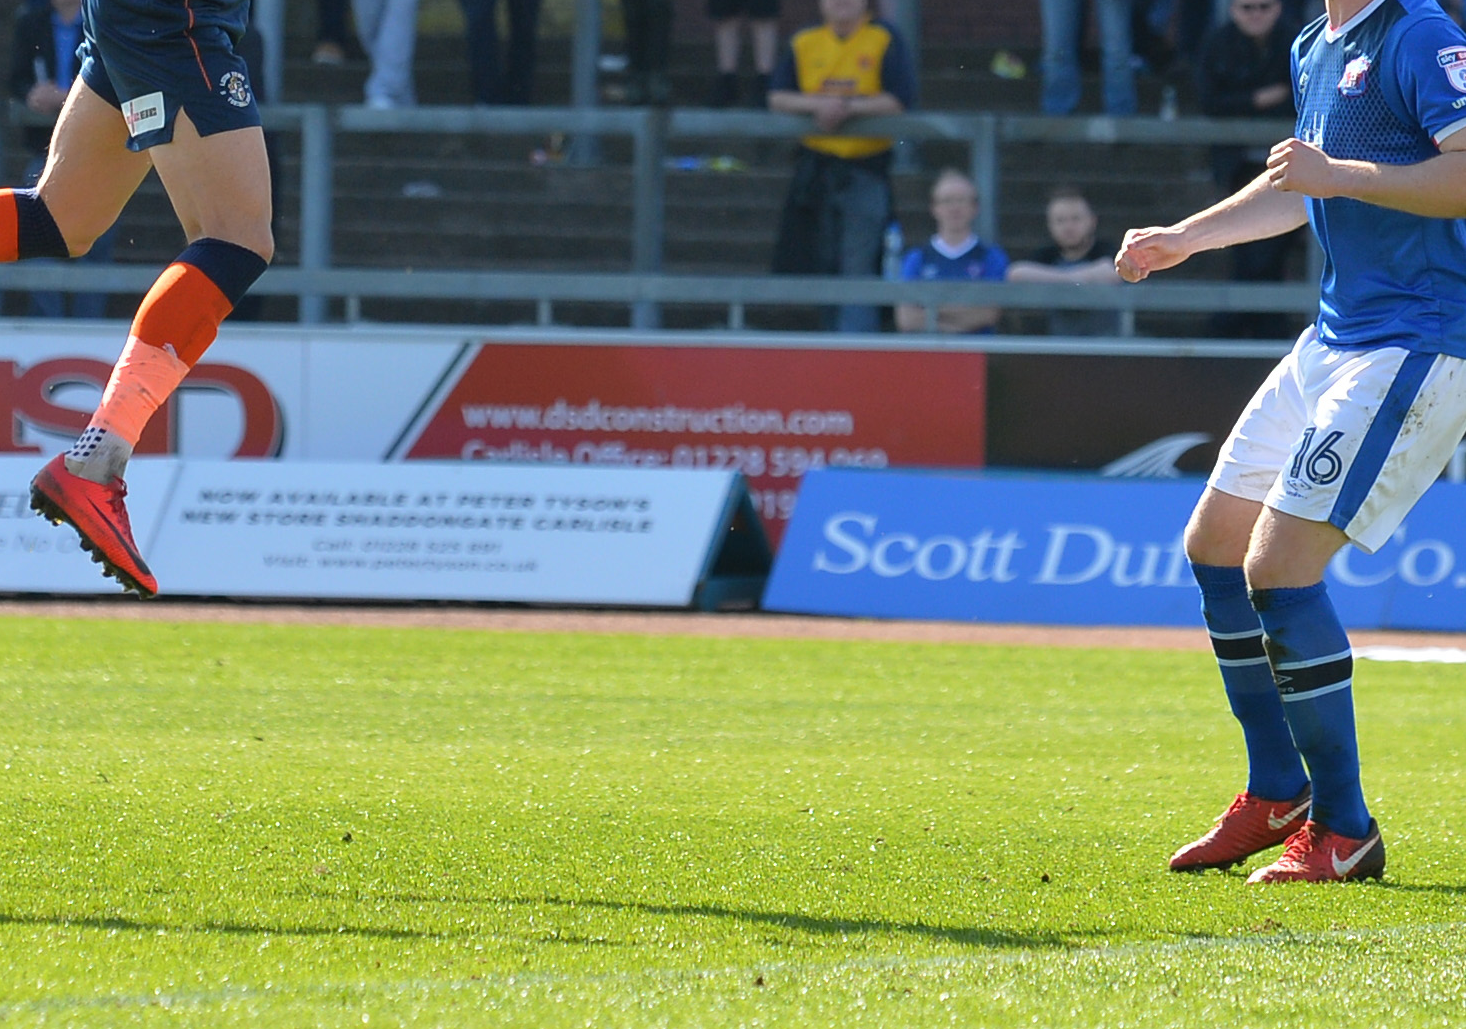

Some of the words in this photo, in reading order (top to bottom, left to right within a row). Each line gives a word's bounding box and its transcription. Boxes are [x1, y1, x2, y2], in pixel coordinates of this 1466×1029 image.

[462, 398, 853, 437] www.dsdconstruction.com
[1290, 426, 1345, 485] 16
[199, 488, 259, 504] NOW
[269, 489, 407, 506] AVAILABLE
[181, 509, 240, 524] NEW
[533, 515, 653, 533] CARLISLE
[814, 511, 1025, 582] Scott
